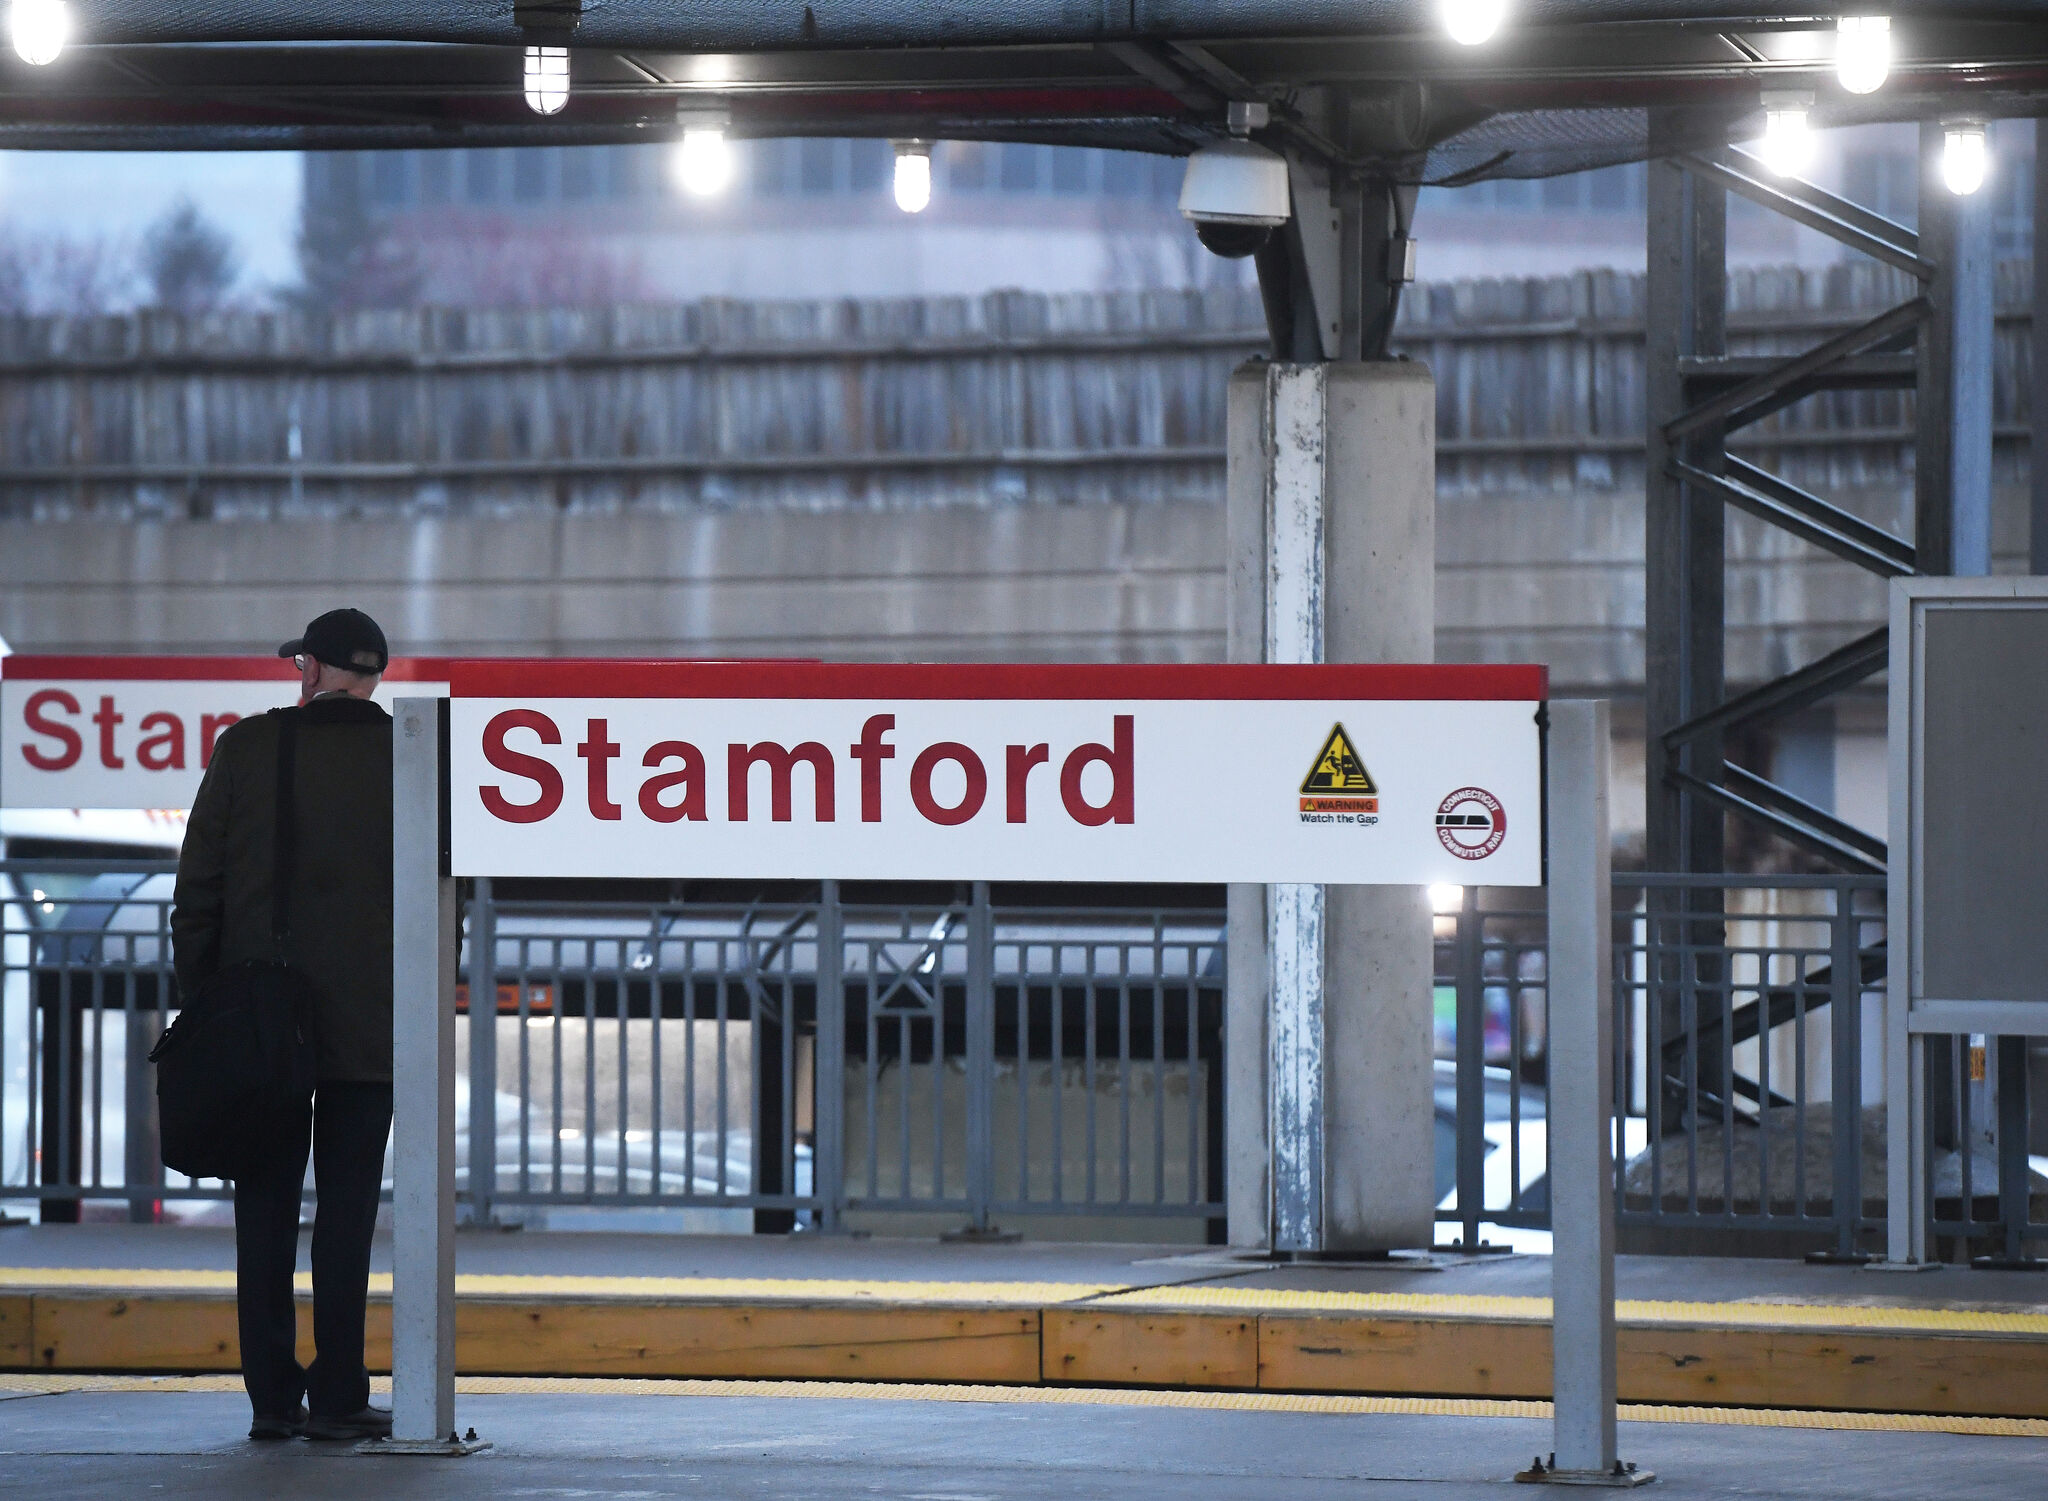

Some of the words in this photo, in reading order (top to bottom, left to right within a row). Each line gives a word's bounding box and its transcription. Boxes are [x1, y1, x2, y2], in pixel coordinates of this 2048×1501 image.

[479, 710, 1136, 826] Stamford
[1316, 801, 1374, 811] WARNING
[1442, 790, 1501, 812] CONNECTICUT
[1300, 813, 1335, 823] Watch
[1336, 813, 1355, 823] the
[1356, 814, 1379, 825] Gap
[1439, 829, 1489, 857] COMMUTER
[1486, 830, 1504, 850] RAIL
